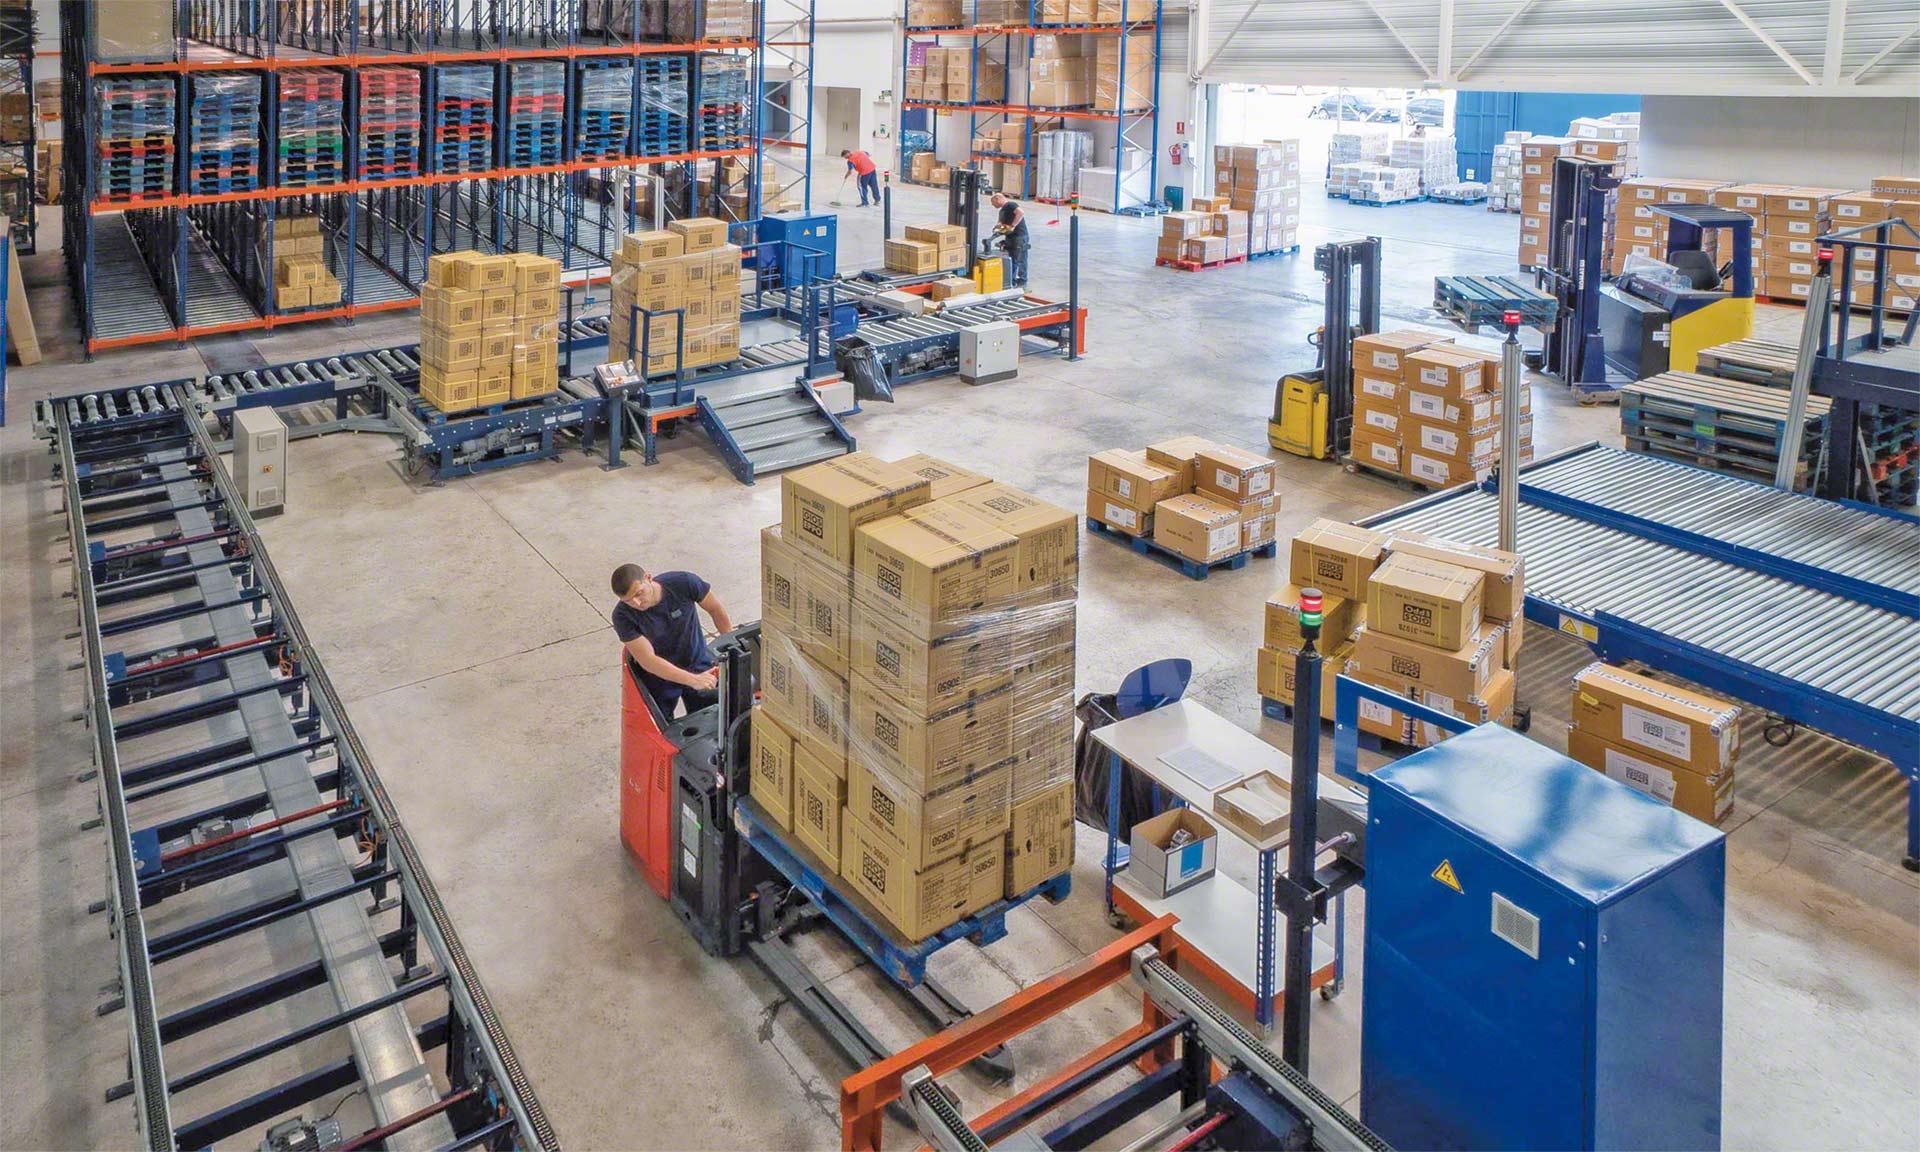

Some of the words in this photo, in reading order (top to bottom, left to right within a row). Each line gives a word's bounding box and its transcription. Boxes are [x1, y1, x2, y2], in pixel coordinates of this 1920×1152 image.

[803, 508, 823, 528] GIOS
[803, 519, 823, 539] EPPO
[878, 564, 901, 588] GIOS
[989, 563, 1010, 579] 30650
[878, 576, 901, 600] EPPO
[1403, 604, 1431, 618] EPPO
[1403, 611, 1431, 628] GIOS
[937, 677, 960, 693] 30650
[873, 785, 895, 813] EPPO
[872, 797, 895, 826] GIOS
[932, 829, 955, 847] 30650
[863, 852, 885, 880] GIOS
[974, 856, 996, 875] 30650
